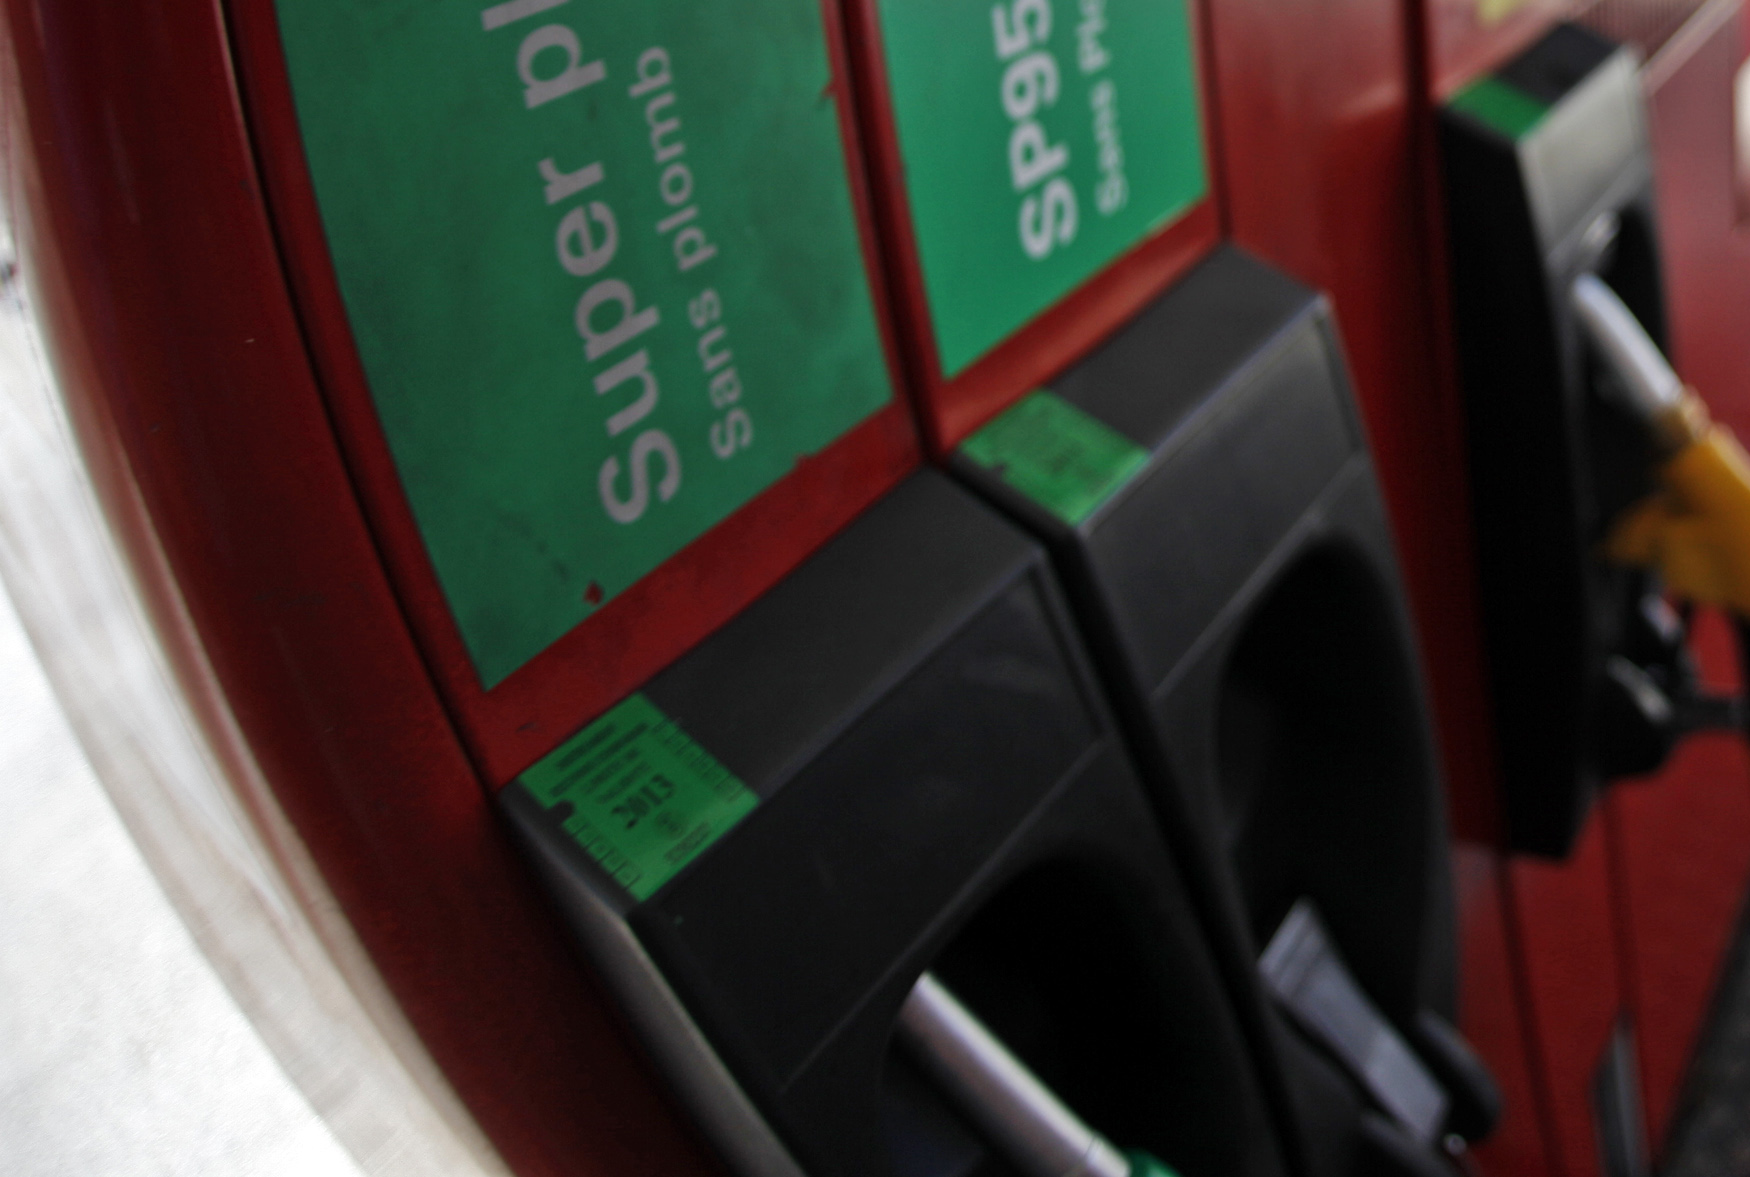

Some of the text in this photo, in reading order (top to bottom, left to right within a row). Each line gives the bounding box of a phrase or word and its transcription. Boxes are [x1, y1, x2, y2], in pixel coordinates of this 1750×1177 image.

[535, 158, 681, 524] Super
[627, 46, 754, 460] Sans plomb
